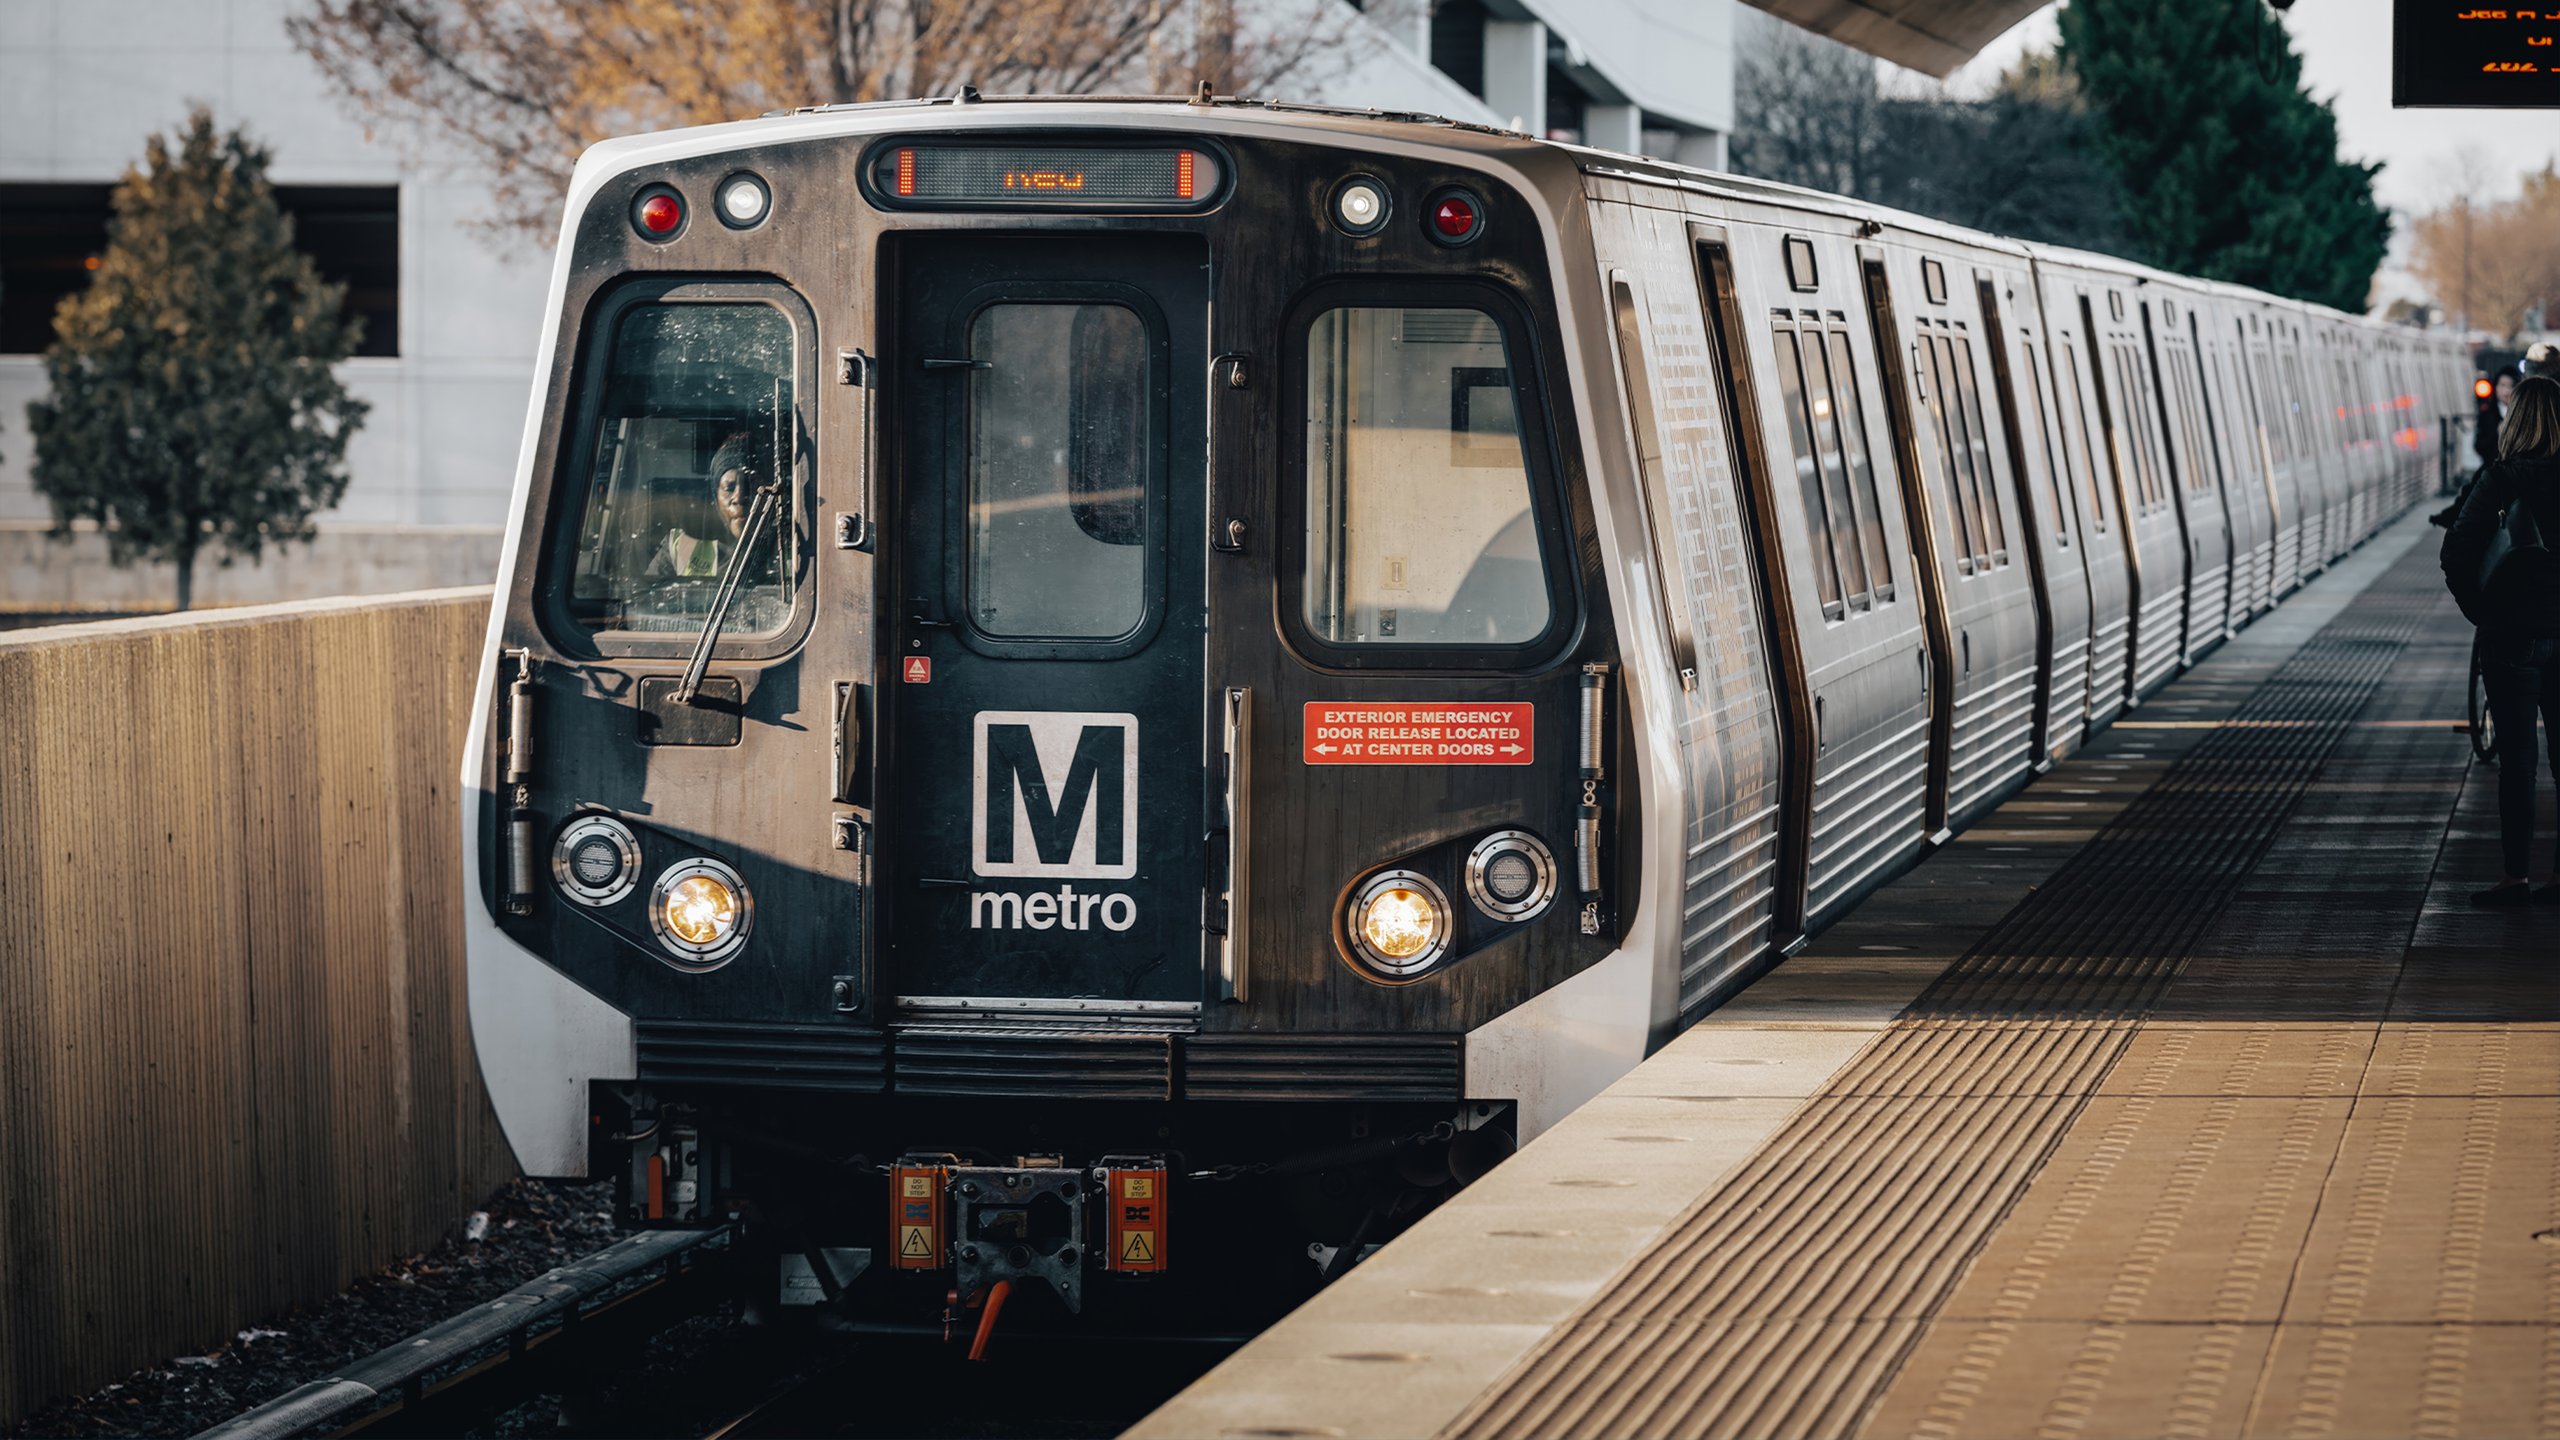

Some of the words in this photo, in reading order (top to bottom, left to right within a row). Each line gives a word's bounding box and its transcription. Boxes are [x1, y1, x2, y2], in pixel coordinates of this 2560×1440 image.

[1324, 711, 1407, 723] EXTERIOR
[1411, 711, 1512, 723] EMERGENCY
[1317, 728, 1363, 739] DOOR
[1368, 728, 1441, 739] RELEASE
[1446, 728, 1520, 739] LOCATED
[1342, 743, 1364, 756] AT
[1368, 743, 1434, 756] CENTER
[1438, 743, 1495, 756] DOORS
[986, 723, 1125, 866] M
[971, 884, 1137, 932] metro
